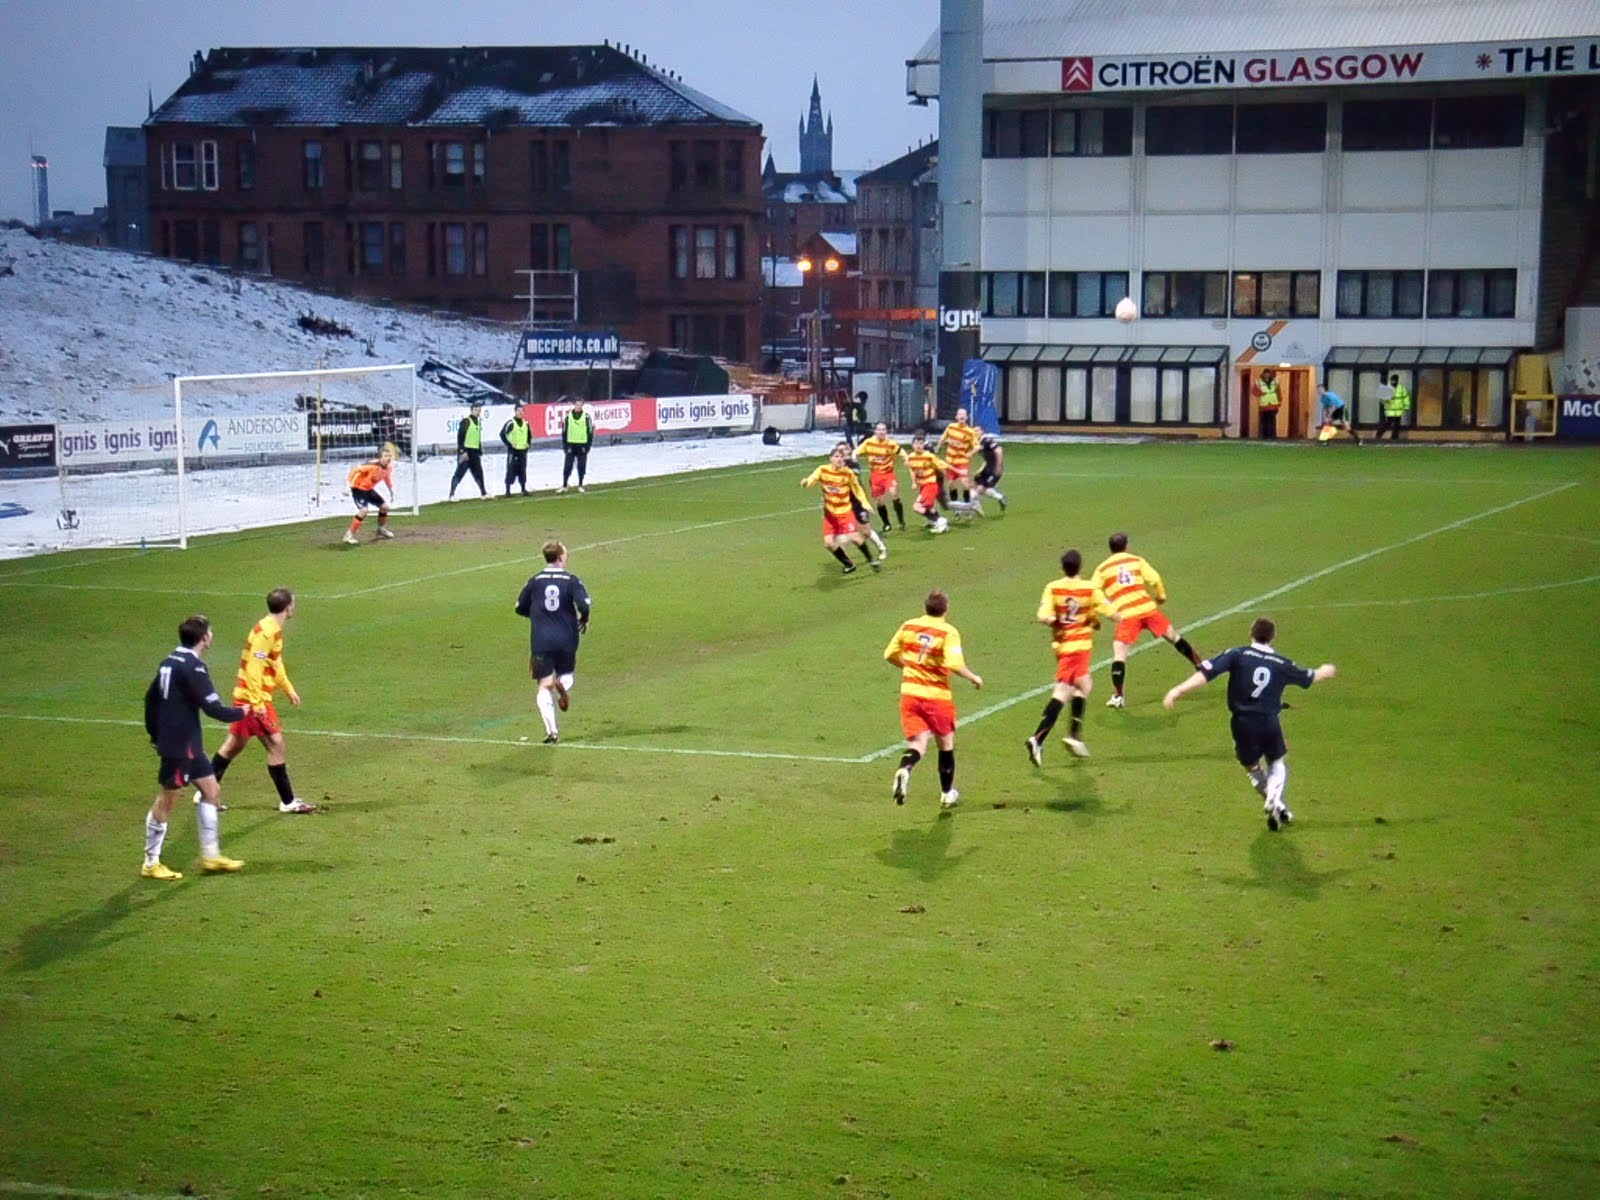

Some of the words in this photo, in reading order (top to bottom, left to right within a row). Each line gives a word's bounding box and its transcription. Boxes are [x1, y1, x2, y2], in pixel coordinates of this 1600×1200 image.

[1098, 55, 1235, 87] CITROËN
[1243, 52, 1424, 83] GLASGOW
[1498, 45, 1575, 73] THE
[940, 304, 981, 332] igni
[228, 416, 299, 435] ANDERSONS
[657, 402, 685, 424] ignis
[689, 400, 716, 422] ignis
[720, 399, 750, 420] ignis
[59, 429, 97, 457] ignis
[104, 427, 142, 454] ignis
[544, 584, 560, 612] 8
[1064, 597, 1079, 622] 2
[917, 633, 932, 663] 7
[1250, 666, 1271, 699] 9
